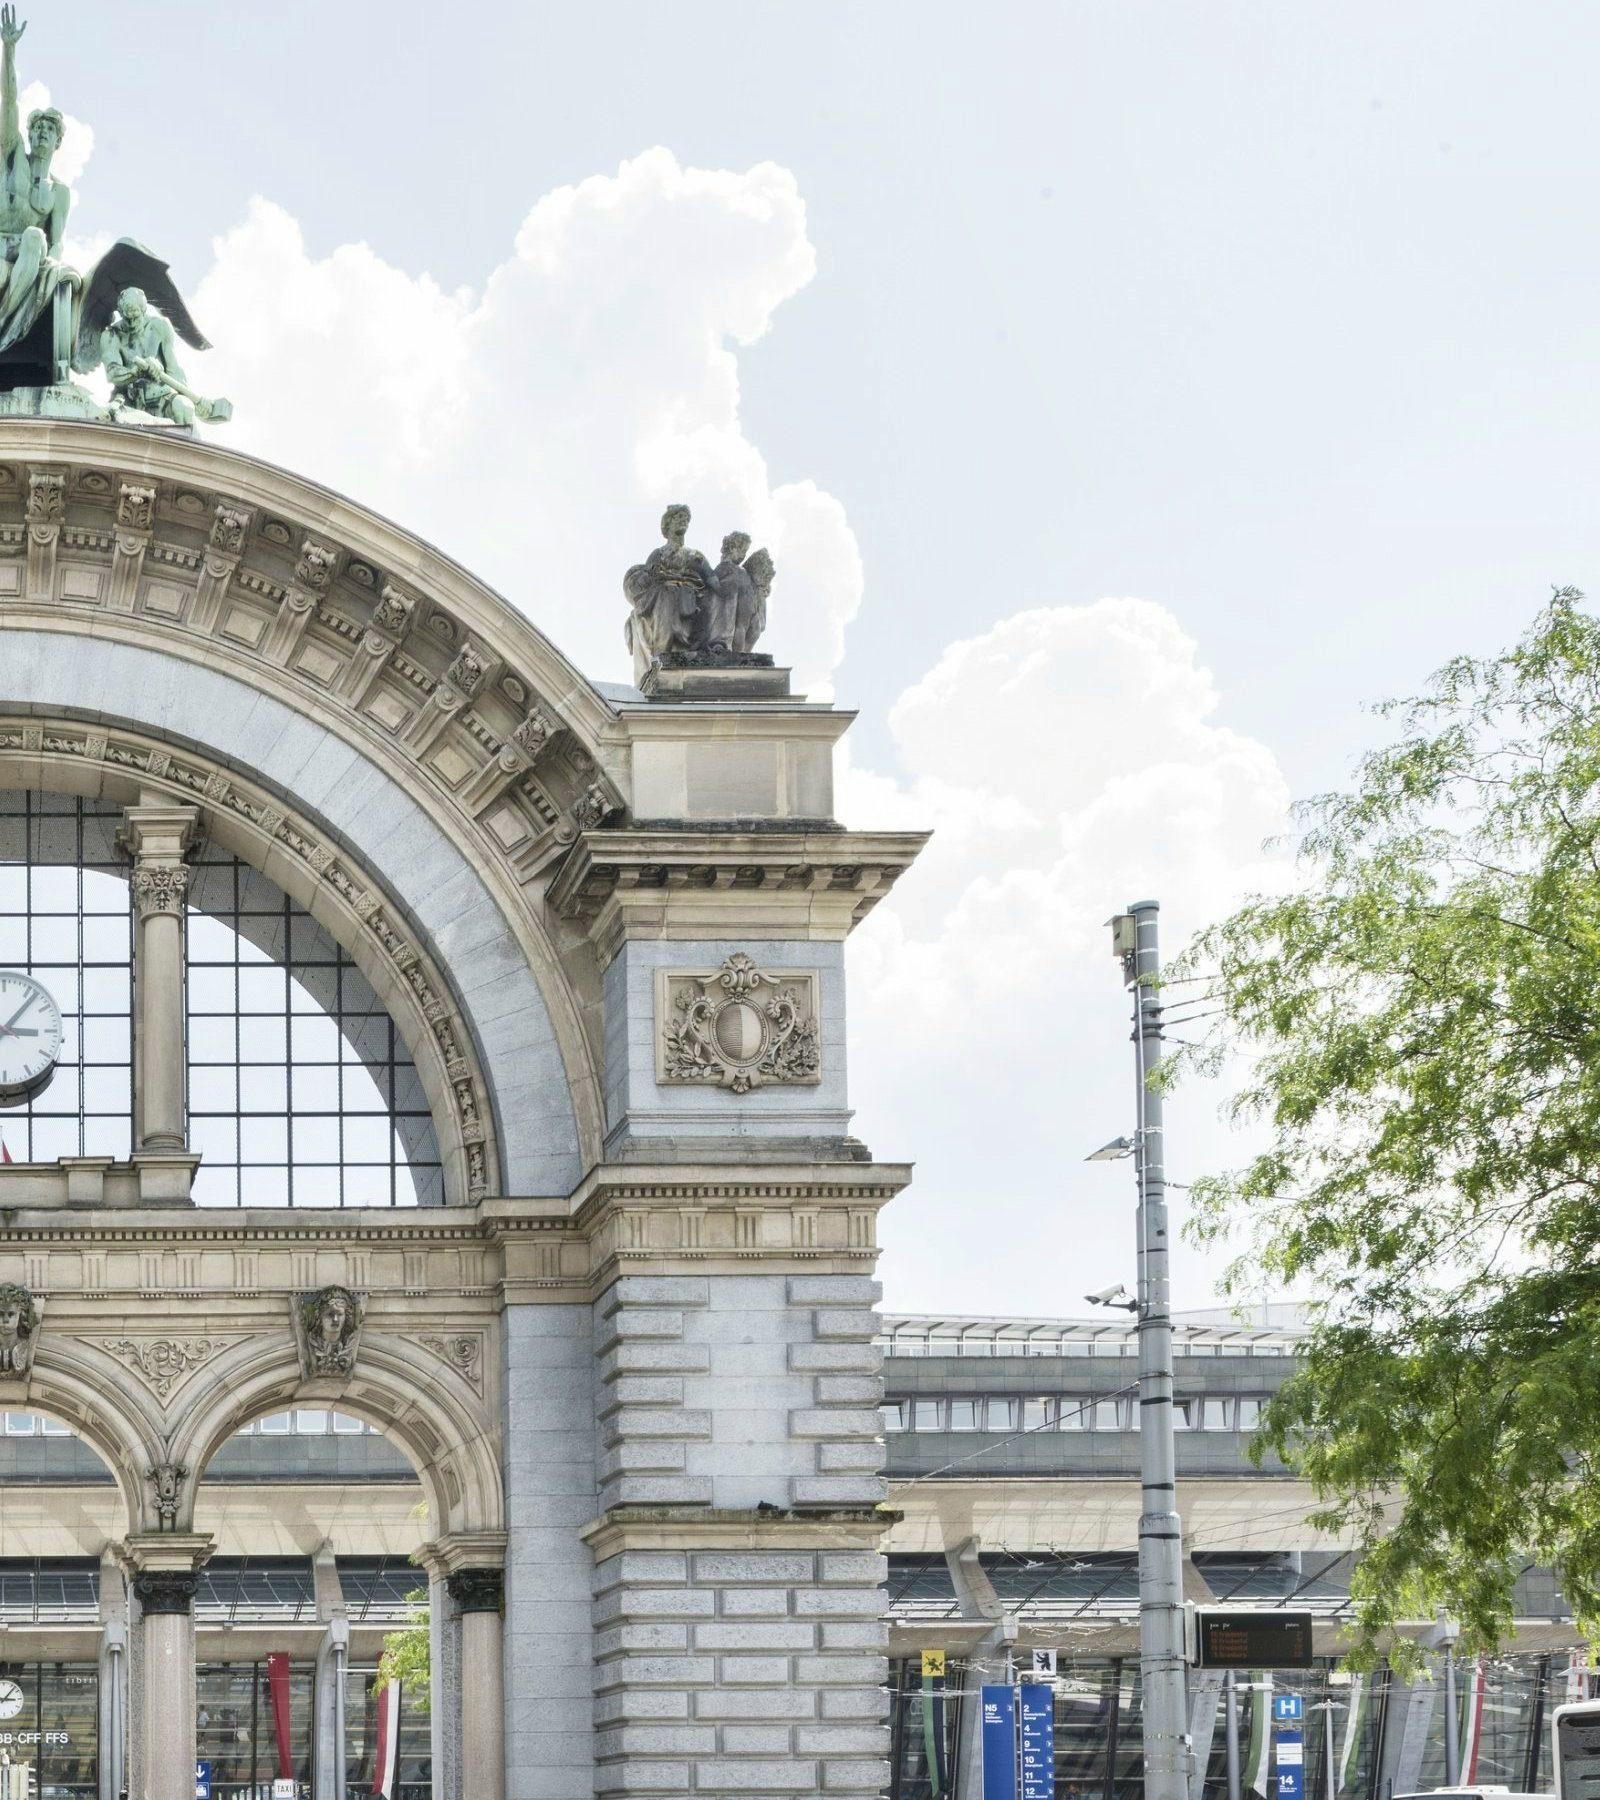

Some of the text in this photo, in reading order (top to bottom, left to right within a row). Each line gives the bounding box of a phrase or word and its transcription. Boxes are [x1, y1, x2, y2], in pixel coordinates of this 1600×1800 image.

[985, 1704, 998, 1712] N5
[1023, 1704, 1030, 1712] 2
[1281, 1700, 1295, 1715] H
[1024, 1724, 1030, 1732] 4
[17, 1733, 42, 1744] CFF
[45, 1733, 69, 1744] FFS
[1024, 1740, 1030, 1748] 9
[1024, 1756, 1035, 1764] 10
[1280, 1775, 1294, 1785] 14
[277, 1785, 292, 1793] TAXI
[1025, 1787, 1036, 1795] 12
